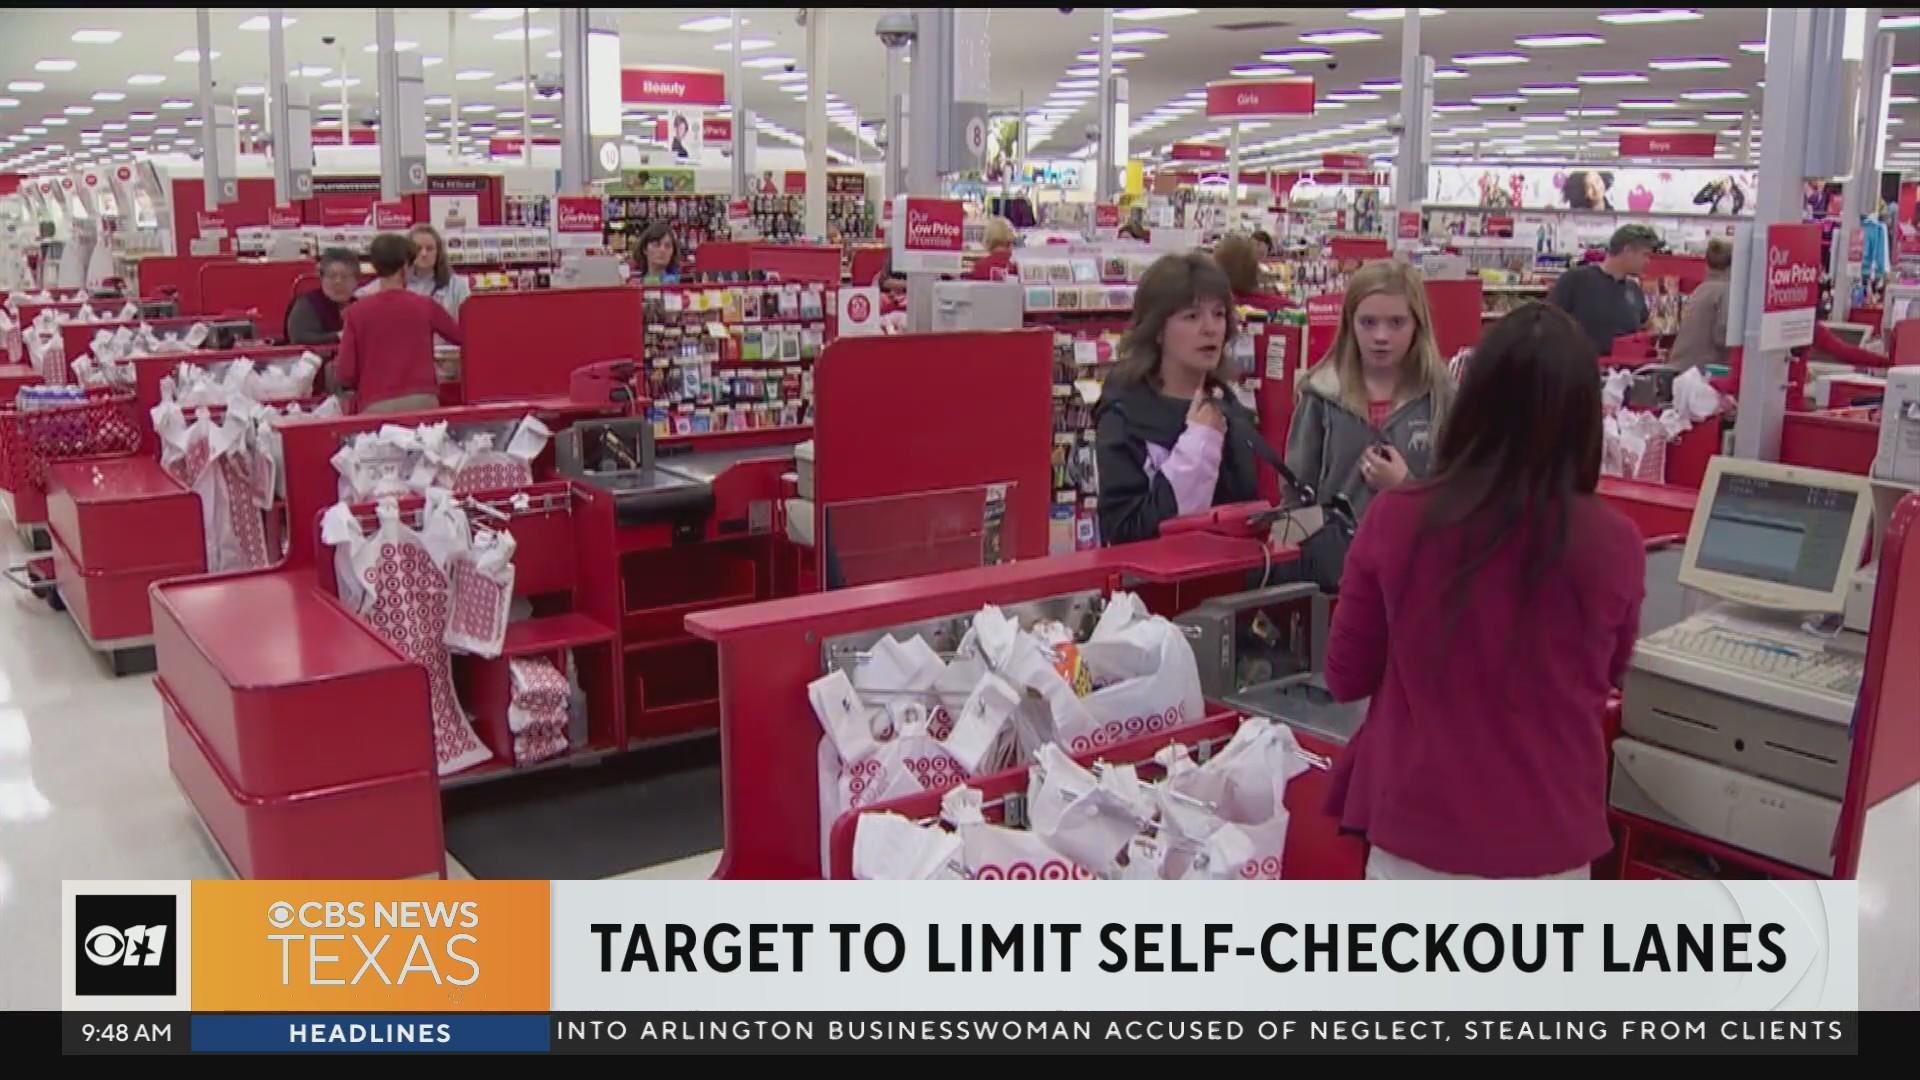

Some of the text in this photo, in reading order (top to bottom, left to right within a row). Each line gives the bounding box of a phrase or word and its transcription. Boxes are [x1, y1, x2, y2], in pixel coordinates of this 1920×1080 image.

[643, 80, 686, 96] Beauty
[1237, 93, 1259, 105] Girls
[974, 126, 982, 147] 8
[605, 150, 616, 164] 10
[909, 209, 928, 221] Our
[909, 221, 960, 236] Low Price
[1769, 246, 1789, 266] Our
[1769, 264, 1816, 285] Low Price
